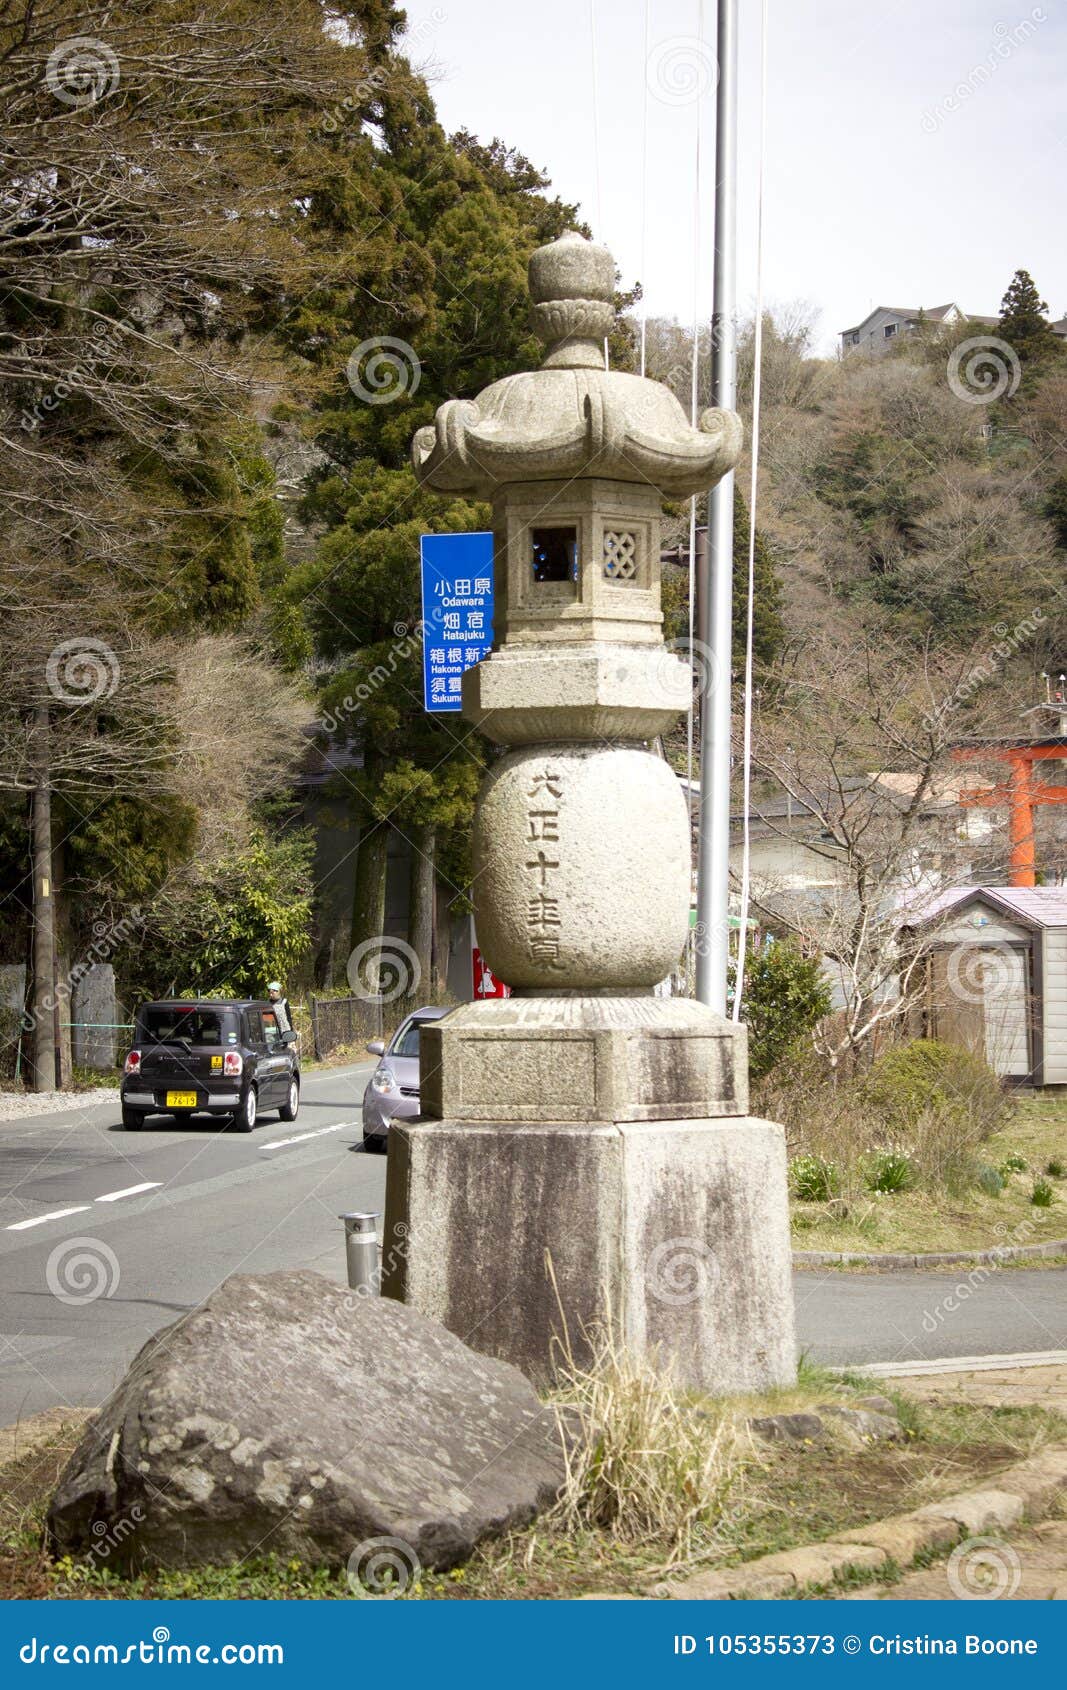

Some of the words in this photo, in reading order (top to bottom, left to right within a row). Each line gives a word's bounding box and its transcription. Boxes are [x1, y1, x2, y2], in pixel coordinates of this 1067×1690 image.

[434, 578, 492, 597] 小田原
[442, 597, 484, 607] Odawara
[443, 630, 485, 642] Hatajuku
[431, 664, 462, 674] Hakone
